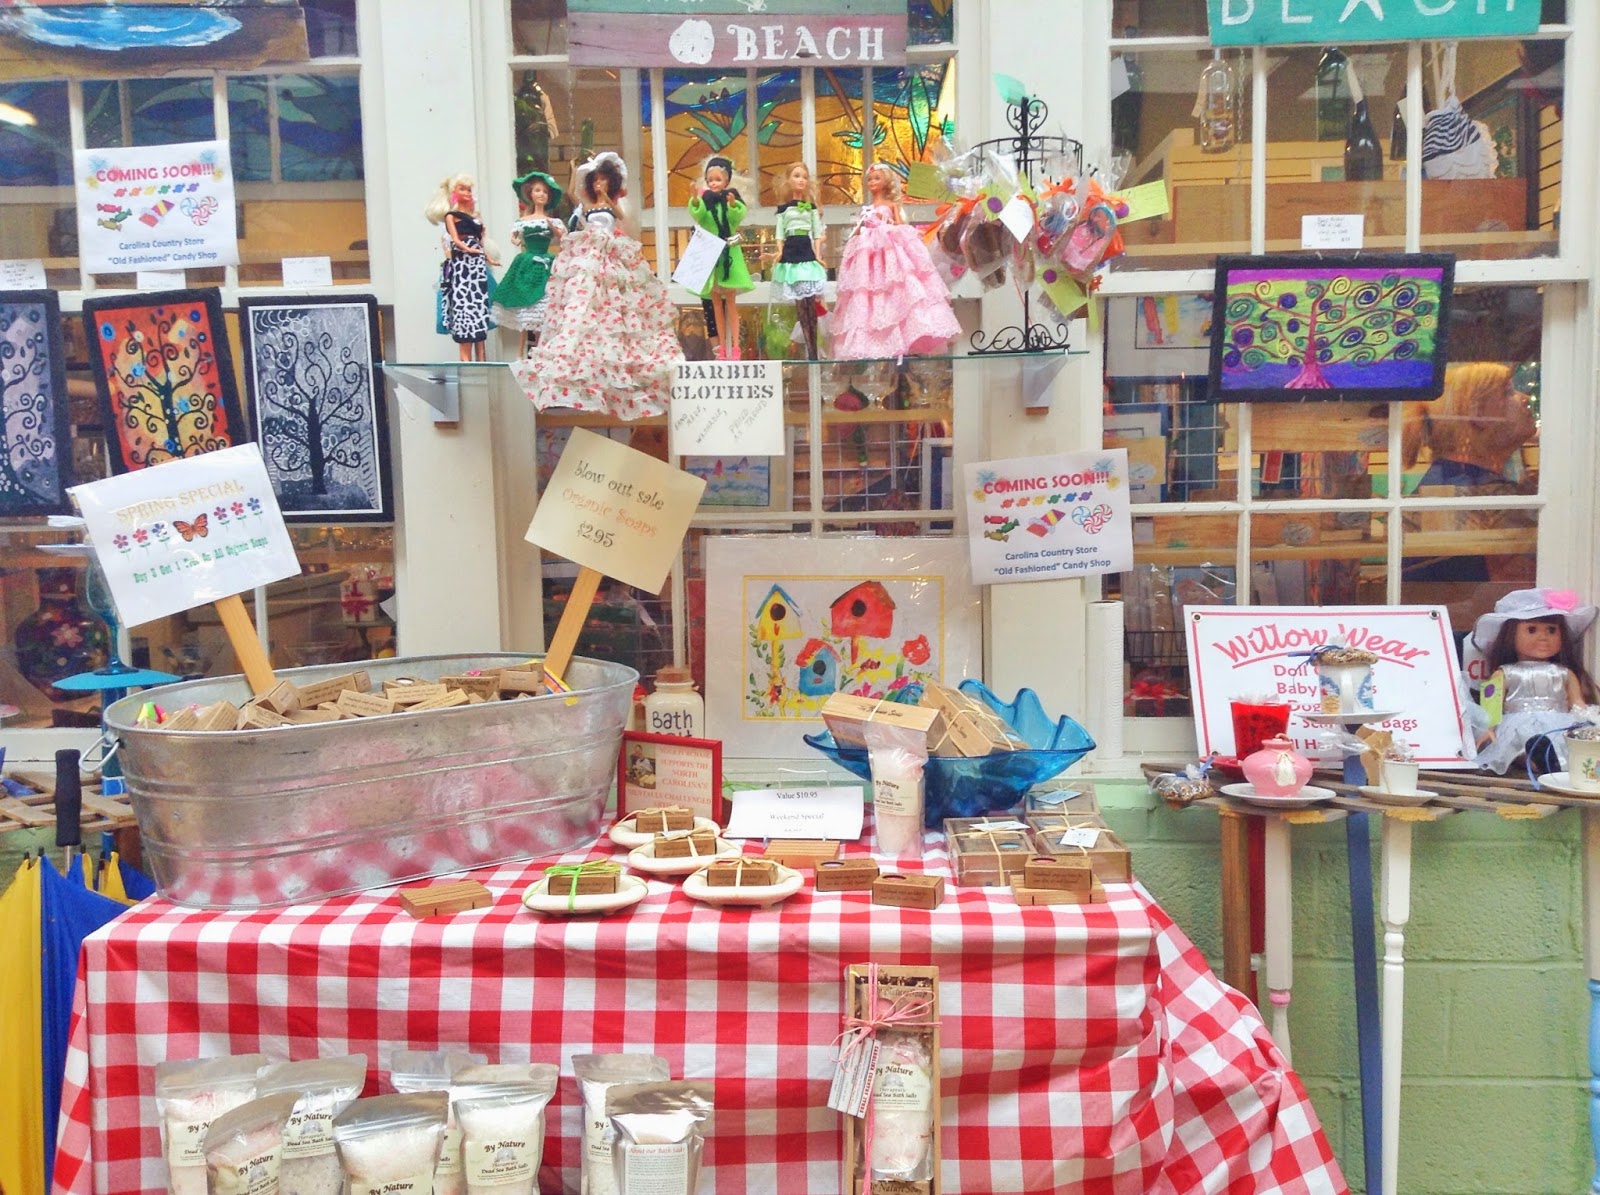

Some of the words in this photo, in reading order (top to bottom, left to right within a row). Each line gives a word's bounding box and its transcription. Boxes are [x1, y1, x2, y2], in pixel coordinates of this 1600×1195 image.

[726, 23, 885, 62] BEACH
[96, 167, 158, 183] COMING
[162, 162, 216, 179] SOON!!!
[119, 240, 151, 251] Carolina
[152, 238, 183, 249] Country
[184, 237, 205, 246] Store
[172, 251, 196, 262] Candy
[197, 250, 218, 261] Shop
[678, 364, 766, 380] BARBIE
[671, 384, 774, 400] CLOTHES
[574, 460, 605, 484] blow
[608, 479, 633, 497] out
[637, 490, 664, 511] sale
[984, 477, 1048, 494] COMING
[1052, 471, 1110, 488] SOON!!!
[116, 497, 177, 522] SPRING
[179, 479, 244, 505] SPECIAL
[562, 487, 612, 518] Organic
[616, 508, 658, 538] Soaps
[577, 521, 616, 548] $2.95
[1005, 551, 1039, 561] Carolina
[1041, 548, 1073, 558] Country
[1075, 545, 1098, 555] Store
[1062, 561, 1088, 571] Candy
[1090, 559, 1112, 569] Shop
[1212, 623, 1329, 663] Willow
[1338, 623, 1431, 662] Wear
[1273, 664, 1308, 677] Doll
[1276, 682, 1317, 697] Baby
[652, 709, 693, 730] Bath
[1381, 719, 1418, 732] Bags
[776, 792, 796, 800] Value
[796, 791, 819, 799] $10.95
[769, 812, 800, 821] Weekend
[884, 1065, 914, 1077] Nature
[290, 1116, 302, 1126] By
[303, 1112, 333, 1122] Nature
[595, 1121, 604, 1130] By
[187, 1125, 200, 1133] By
[484, 1144, 496, 1153] By
[497, 1140, 526, 1149] Nature
[238, 1165, 248, 1176] By
[249, 1154, 274, 1168] Nature
[383, 1183, 414, 1193] Nature
